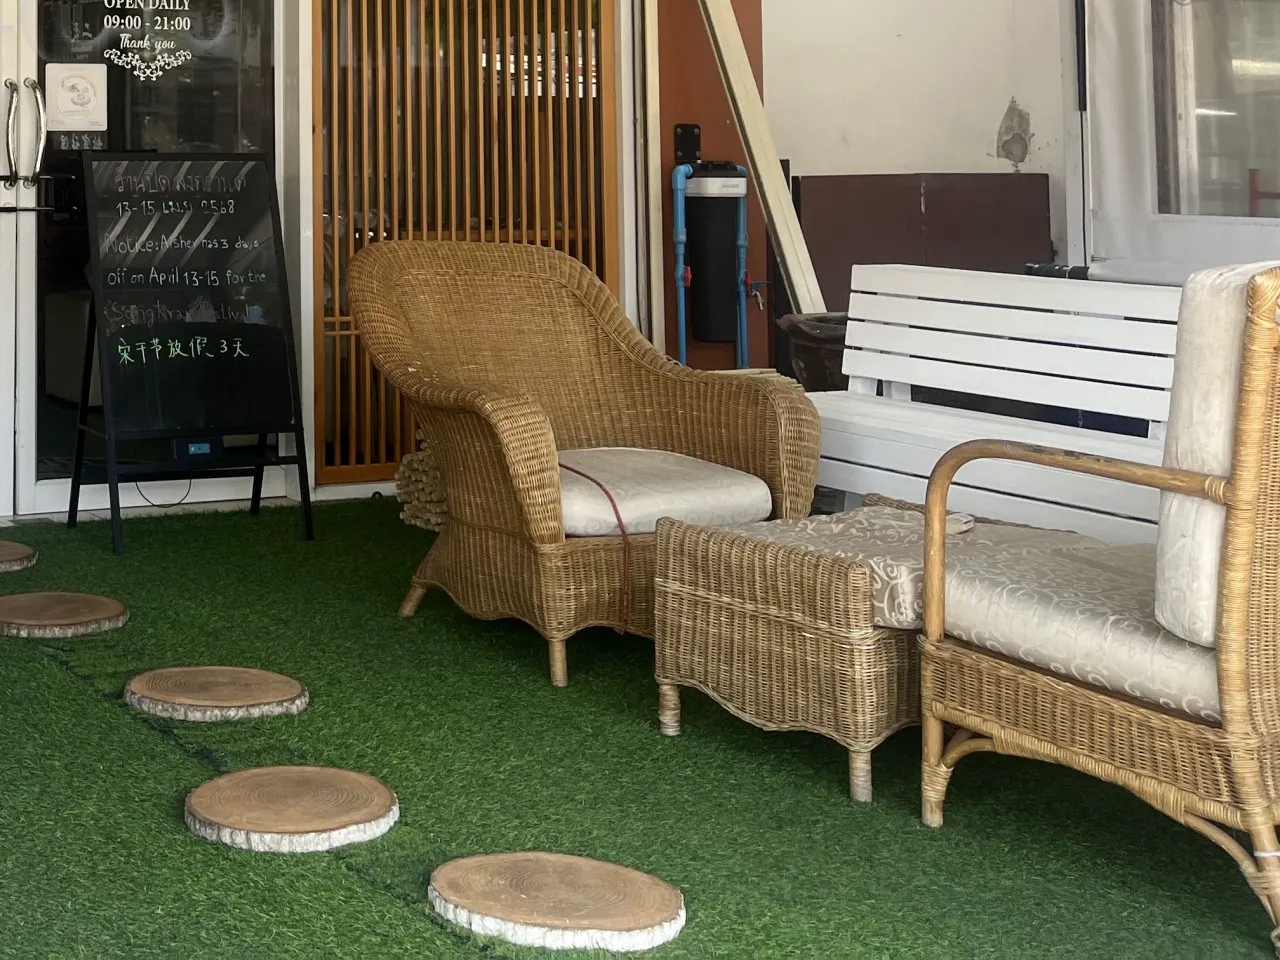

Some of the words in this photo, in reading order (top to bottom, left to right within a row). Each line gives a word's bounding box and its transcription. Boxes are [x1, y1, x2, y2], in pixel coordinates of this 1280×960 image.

[103, 14, 142, 30] 09:00
[153, 16, 191, 31] 21:00
[119, 33, 151, 49] Thank
[153, 39, 177, 54] you
[115, 200, 156, 217] 13-15
[200, 200, 236, 215] 2568
[233, 235, 260, 252] days
[130, 271, 145, 283] on
[148, 265, 180, 286] April
[182, 269, 220, 287] 13-15
[224, 269, 245, 284] for
[247, 268, 267, 284] the
